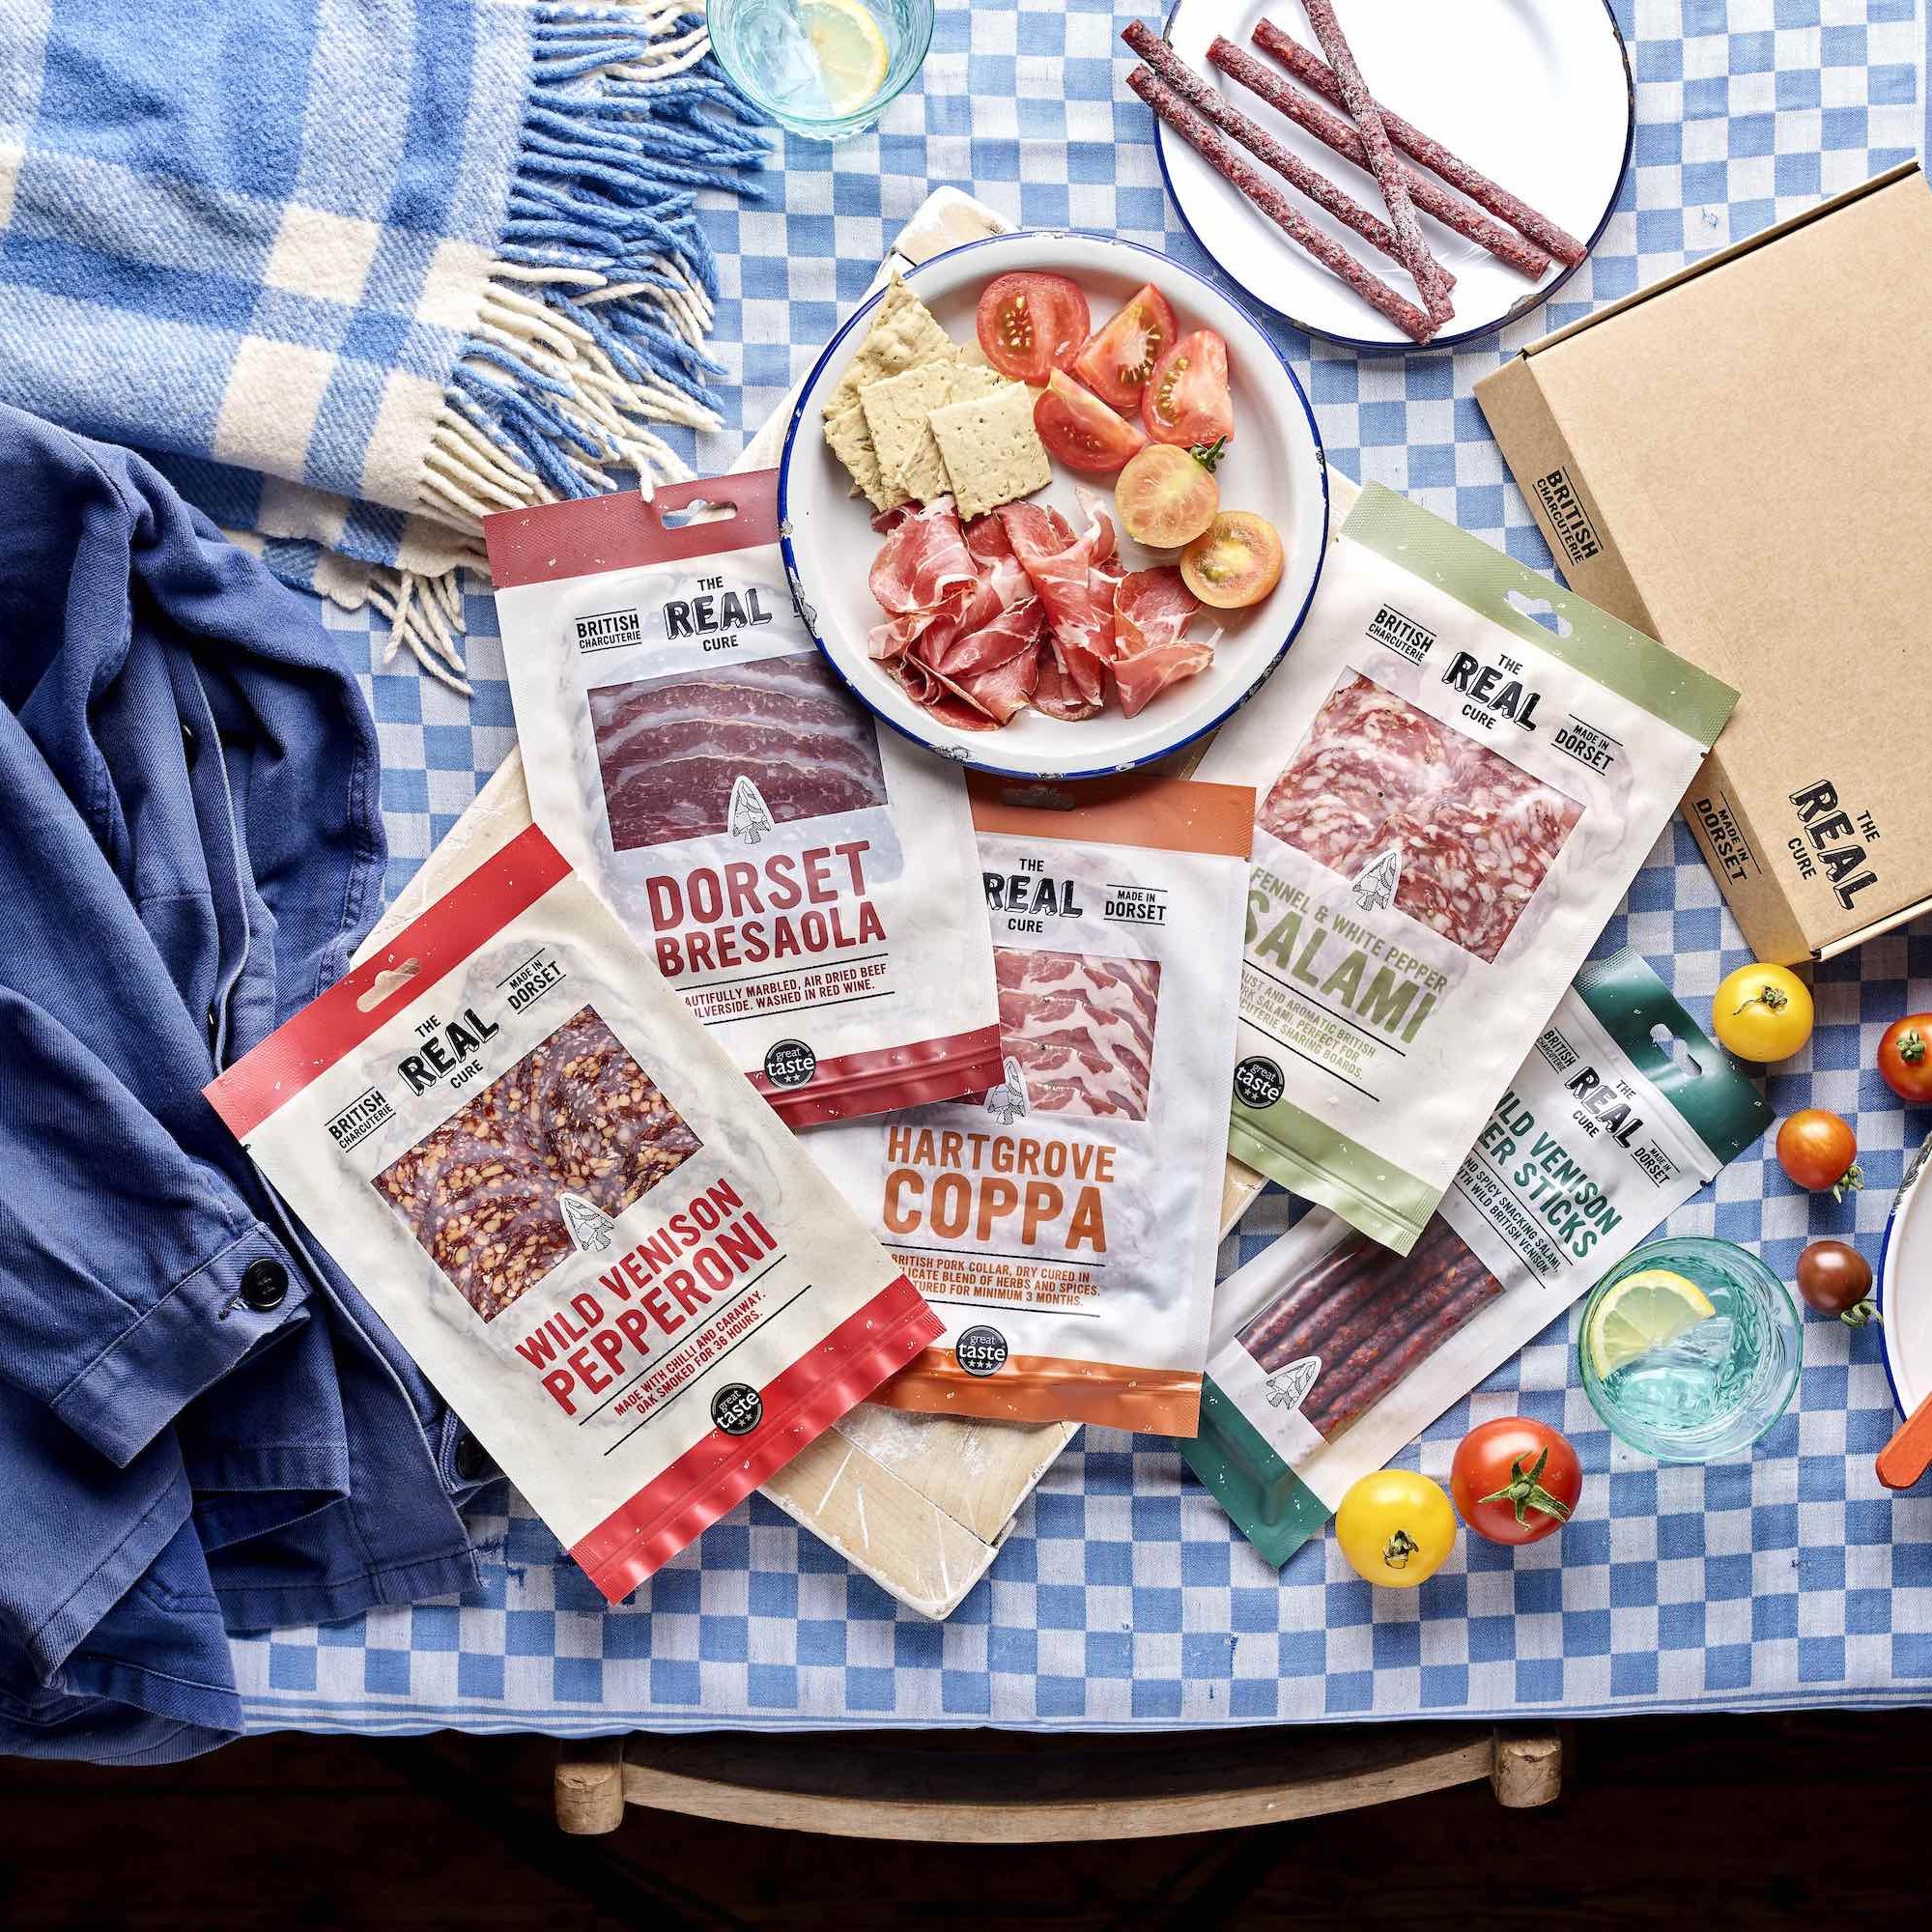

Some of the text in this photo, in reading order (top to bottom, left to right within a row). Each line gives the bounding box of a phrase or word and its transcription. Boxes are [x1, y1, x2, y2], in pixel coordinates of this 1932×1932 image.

[1536, 478, 1585, 563] CHARCUTERIE
[1546, 469, 1600, 558] BRITISH
[697, 576, 724, 591] THE
[576, 613, 639, 639] BRITISH
[664, 588, 772, 639] REAL
[1374, 609, 1435, 653] BRITISH
[579, 631, 641, 649] CHARCUTERIE
[703, 636, 738, 652] CURE
[1368, 623, 1426, 662] CHARCUTERIE
[1497, 654, 1523, 674] THE
[1441, 651, 1542, 732] REAL
[1462, 704, 1496, 730] CURE
[1554, 728, 1614, 770] DORSET
[1574, 724, 1610, 751] MADE IN
[1696, 797, 1747, 881] DORSET
[1719, 809, 1748, 863] MADE IN
[1789, 780, 1879, 911] REAL
[1857, 810, 1881, 843] THE
[1019, 858, 1044, 872] THE
[1787, 837, 1817, 881] CURE
[645, 840, 870, 931] DORSET
[982, 872, 1083, 918] REAL
[1118, 891, 1155, 902] MADE IN
[1008, 919, 1043, 933] CURE
[1105, 900, 1167, 921] DORSET
[1250, 867, 1448, 993] FENNEL & WHITE PEPPER
[655, 901, 887, 978] BRESAOLA
[507, 961, 562, 1010] DORSET
[510, 959, 542, 988] MADE IN
[746, 979, 801, 998] MARBLED,
[805, 975, 822, 987] AIR
[826, 969, 857, 983] DRIED
[861, 964, 887, 978] BEEF
[756, 993, 801, 1009] WASHED
[806, 990, 816, 1000] IN
[819, 985, 840, 998] RED
[843, 979, 875, 993] WINE.
[414, 1014, 441, 1037] THE
[1239, 997, 1363, 1080] CUTERIE SHARING BOARDS.
[1264, 987, 1286, 1004] AND
[1287, 999, 1336, 1035] AROMATIC
[1336, 1030, 1376, 1057] BRITISH
[1295, 1019, 1339, 1048] PERFECT
[1340, 1044, 1361, 1062] FOR
[397, 1009, 498, 1096] REAL
[765, 1056, 815, 1077] taste
[776, 1046, 801, 1062] great
[1537, 1037, 1567, 1072] CHARCUTERIE
[1543, 1030, 1577, 1066] BRITISH
[450, 1060, 483, 1089] CURE
[1237, 1066, 1279, 1100] taste
[1250, 1065, 1275, 1082] great
[1616, 1079, 1636, 1099] THE
[328, 1091, 386, 1141] BRITISH
[338, 1103, 393, 1150] CHARCUTERIE
[1564, 1066, 1643, 1149] REAL
[1572, 1110, 1600, 1138] CURE
[888, 1125, 1117, 1183] HARTGROVE
[1494, 1087, 1622, 1236] ILD VENISON
[1634, 1147, 1670, 1184] DORSET
[1649, 1149, 1671, 1171] MADE IN
[1477, 1117, 1598, 1258] ER STICKS
[1477, 1171, 1502, 1197] SPICY
[1498, 1197, 1538, 1243] SNACKING
[883, 1168, 1107, 1252] COPPA
[1471, 1183, 1492, 1207] WILD
[1490, 1206, 1521, 1240] BRITISH
[1518, 1238, 1550, 1276] VENISON.
[515, 1178, 744, 1371] WILD VENISON
[899, 1267, 1100, 1295] ICATE BLEND OF HERBS AND SPICES.
[936, 1258, 965, 1272] PORK
[969, 1262, 1011, 1277] COLLAR,
[1016, 1265, 1037, 1278] DRY
[1040, 1268, 1075, 1281] CURED
[1078, 1271, 1090, 1283] IN
[542, 1211, 778, 1416] PEPPERONI
[949, 1284, 970, 1295] FOR
[973, 1286, 1022, 1301] MINIMUM
[1026, 1291, 1033, 1302] 3
[1036, 1292, 1084, 1306] MONTHS.
[614, 1290, 766, 1417] MADE WITH CHILLI AND CARAWAY.
[958, 1343, 1006, 1361] taste
[970, 1334, 995, 1348] great
[637, 1310, 763, 1414] OAK SMOKED FOR 36 HOURS.
[717, 1389, 759, 1430] taste
[718, 1390, 740, 1412] great
